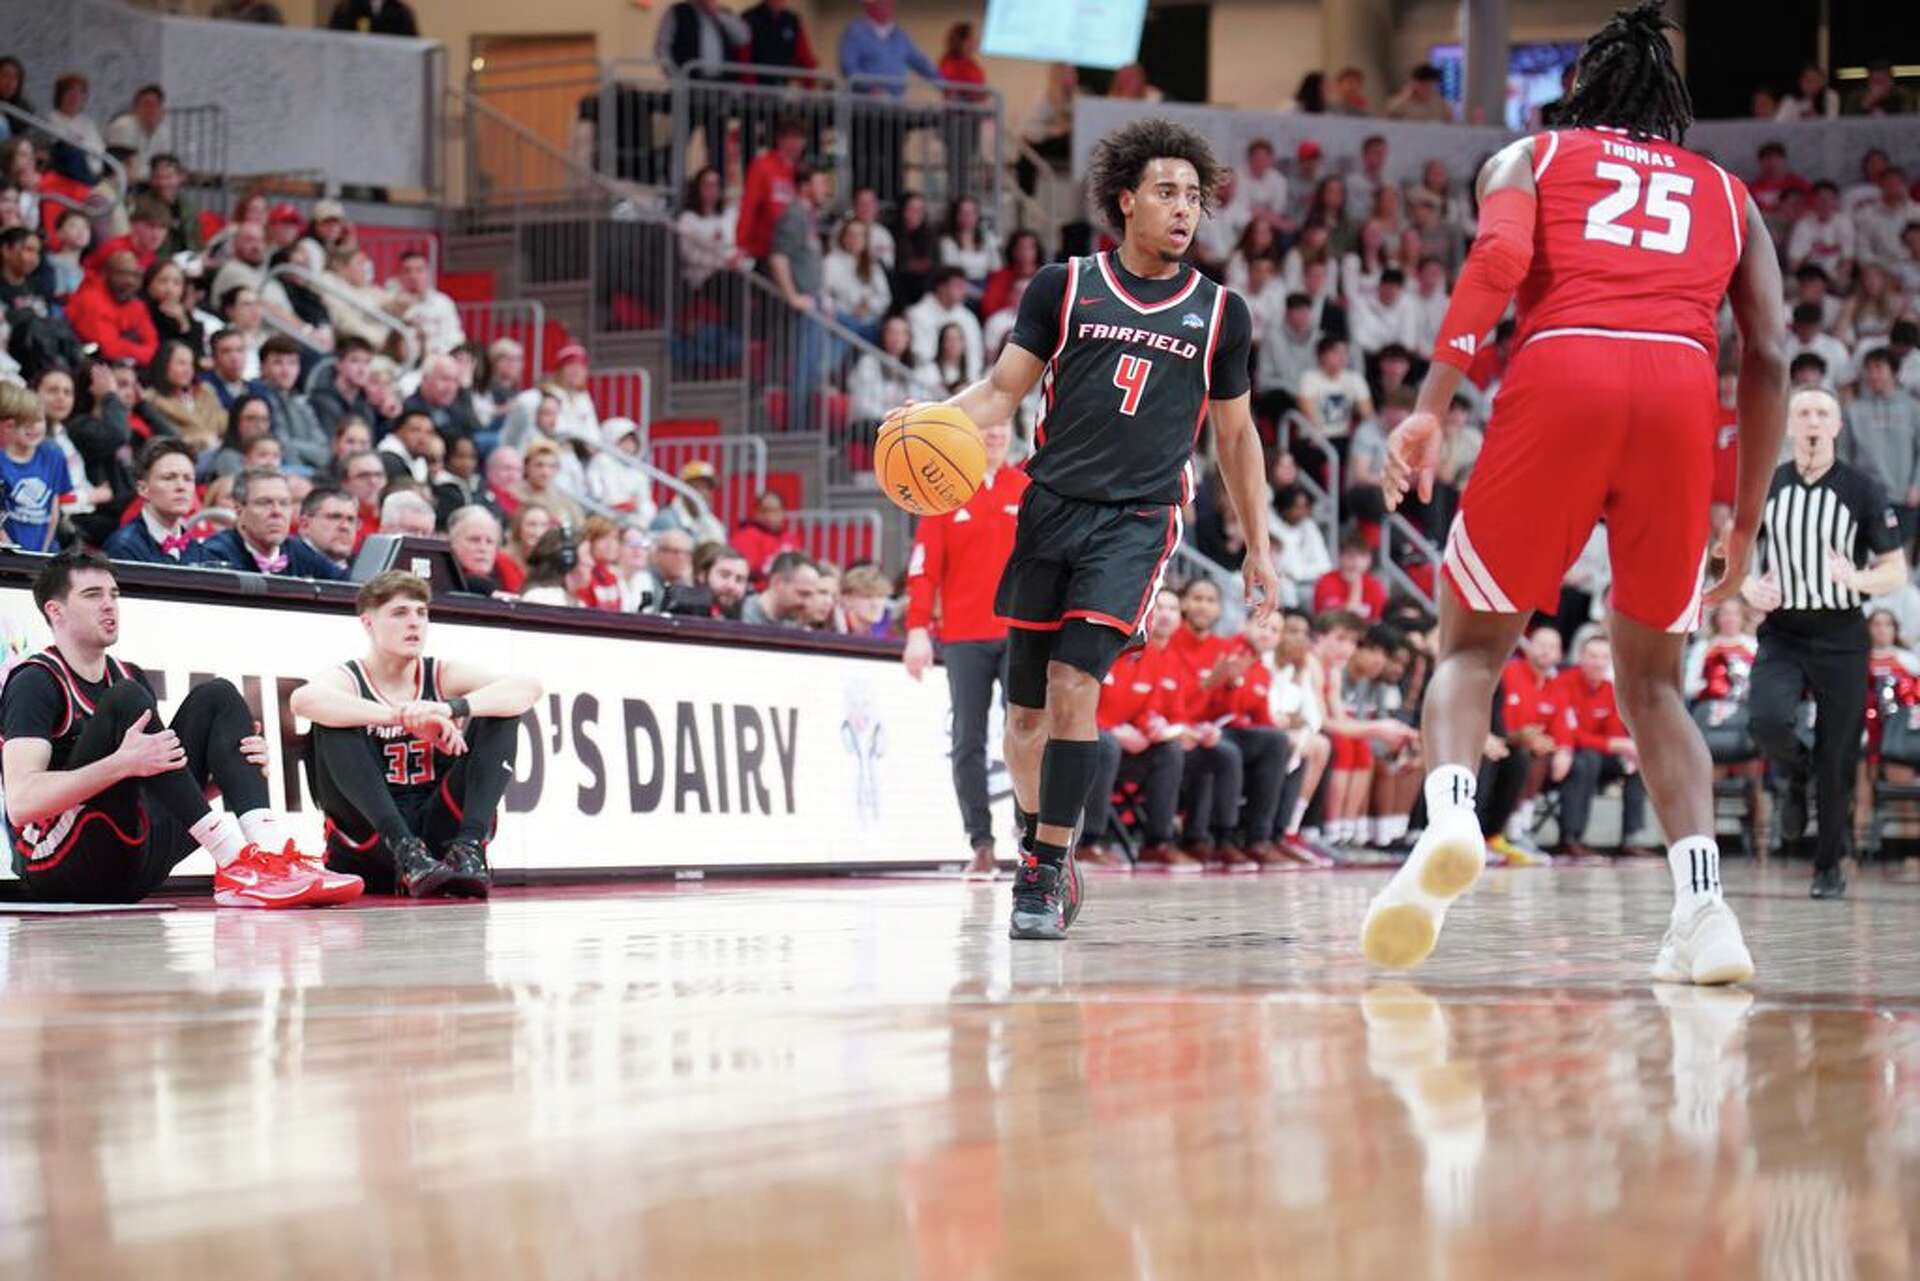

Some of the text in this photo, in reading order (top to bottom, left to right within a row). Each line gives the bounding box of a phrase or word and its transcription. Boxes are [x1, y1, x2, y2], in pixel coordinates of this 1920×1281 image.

[1602, 140, 1676, 168] THOMAS
[1584, 161, 1694, 254] 25
[1078, 323, 1198, 360] FAIRFIELD
[1113, 353, 1152, 416] 4
[384, 741, 436, 785] 33
[622, 698, 799, 815] DAIRY
